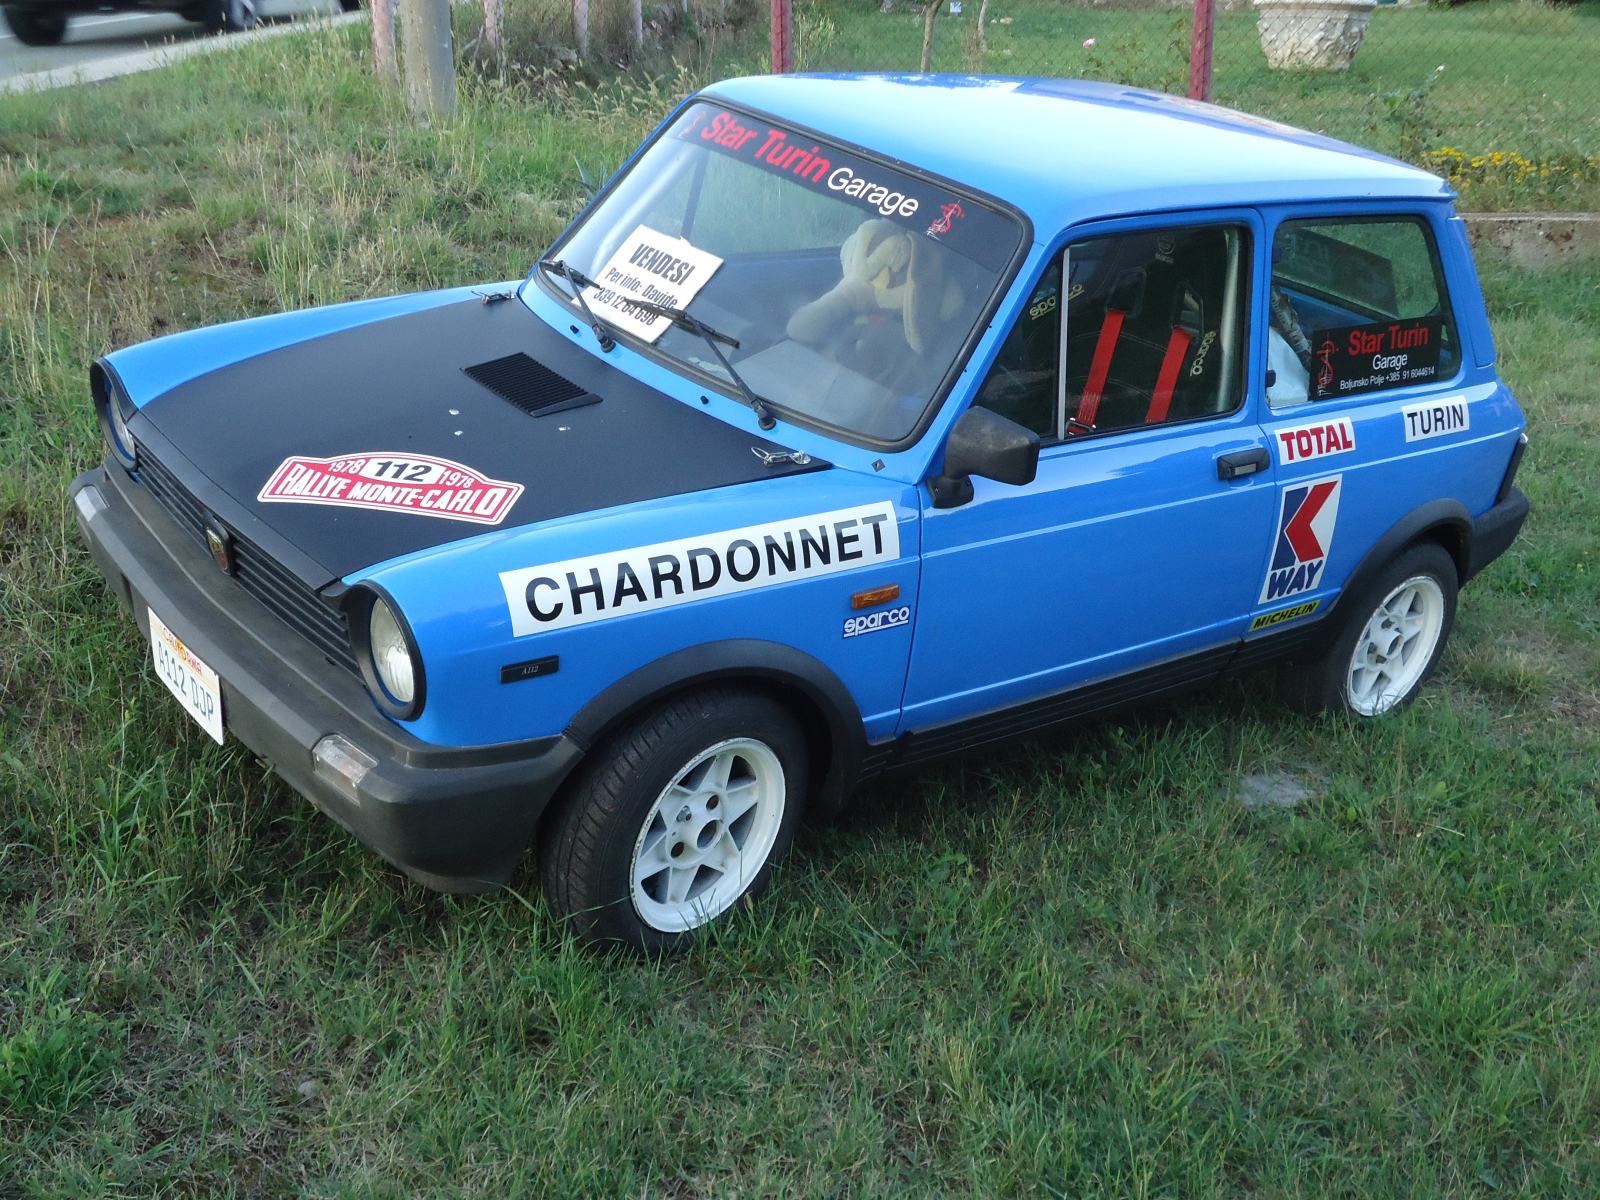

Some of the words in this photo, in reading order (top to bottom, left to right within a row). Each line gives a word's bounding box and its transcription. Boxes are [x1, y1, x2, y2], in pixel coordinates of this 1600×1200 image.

[701, 111, 757, 150] Star
[755, 128, 830, 183] Turin
[827, 167, 919, 217] Garage
[628, 243, 696, 286] VENDESI
[594, 287, 615, 305] 339
[612, 295, 626, 310] 12
[605, 267, 625, 283] Per
[620, 273, 643, 293] info:
[642, 284, 678, 309] Davide
[1348, 330, 1384, 357] Star
[1388, 322, 1431, 350] Turin
[1372, 354, 1408, 370] Garage
[1386, 371, 1400, 382] +385
[1402, 370, 1410, 380] 91
[1407, 403, 1465, 437] TURIN
[1280, 422, 1353, 461] TOTAL
[274, 463, 352, 499] RALLYE
[349, 481, 508, 517] MONTE-CARLO
[328, 458, 367, 474] 1978
[375, 460, 433, 483] 112
[438, 469, 475, 488] 1978
[525, 513, 888, 622] CHARDONNET
[1266, 560, 1324, 601] WAY
[843, 606, 911, 637] sparco
[1252, 601, 1318, 630] MICHELIN
[158, 640, 188, 697] A112
